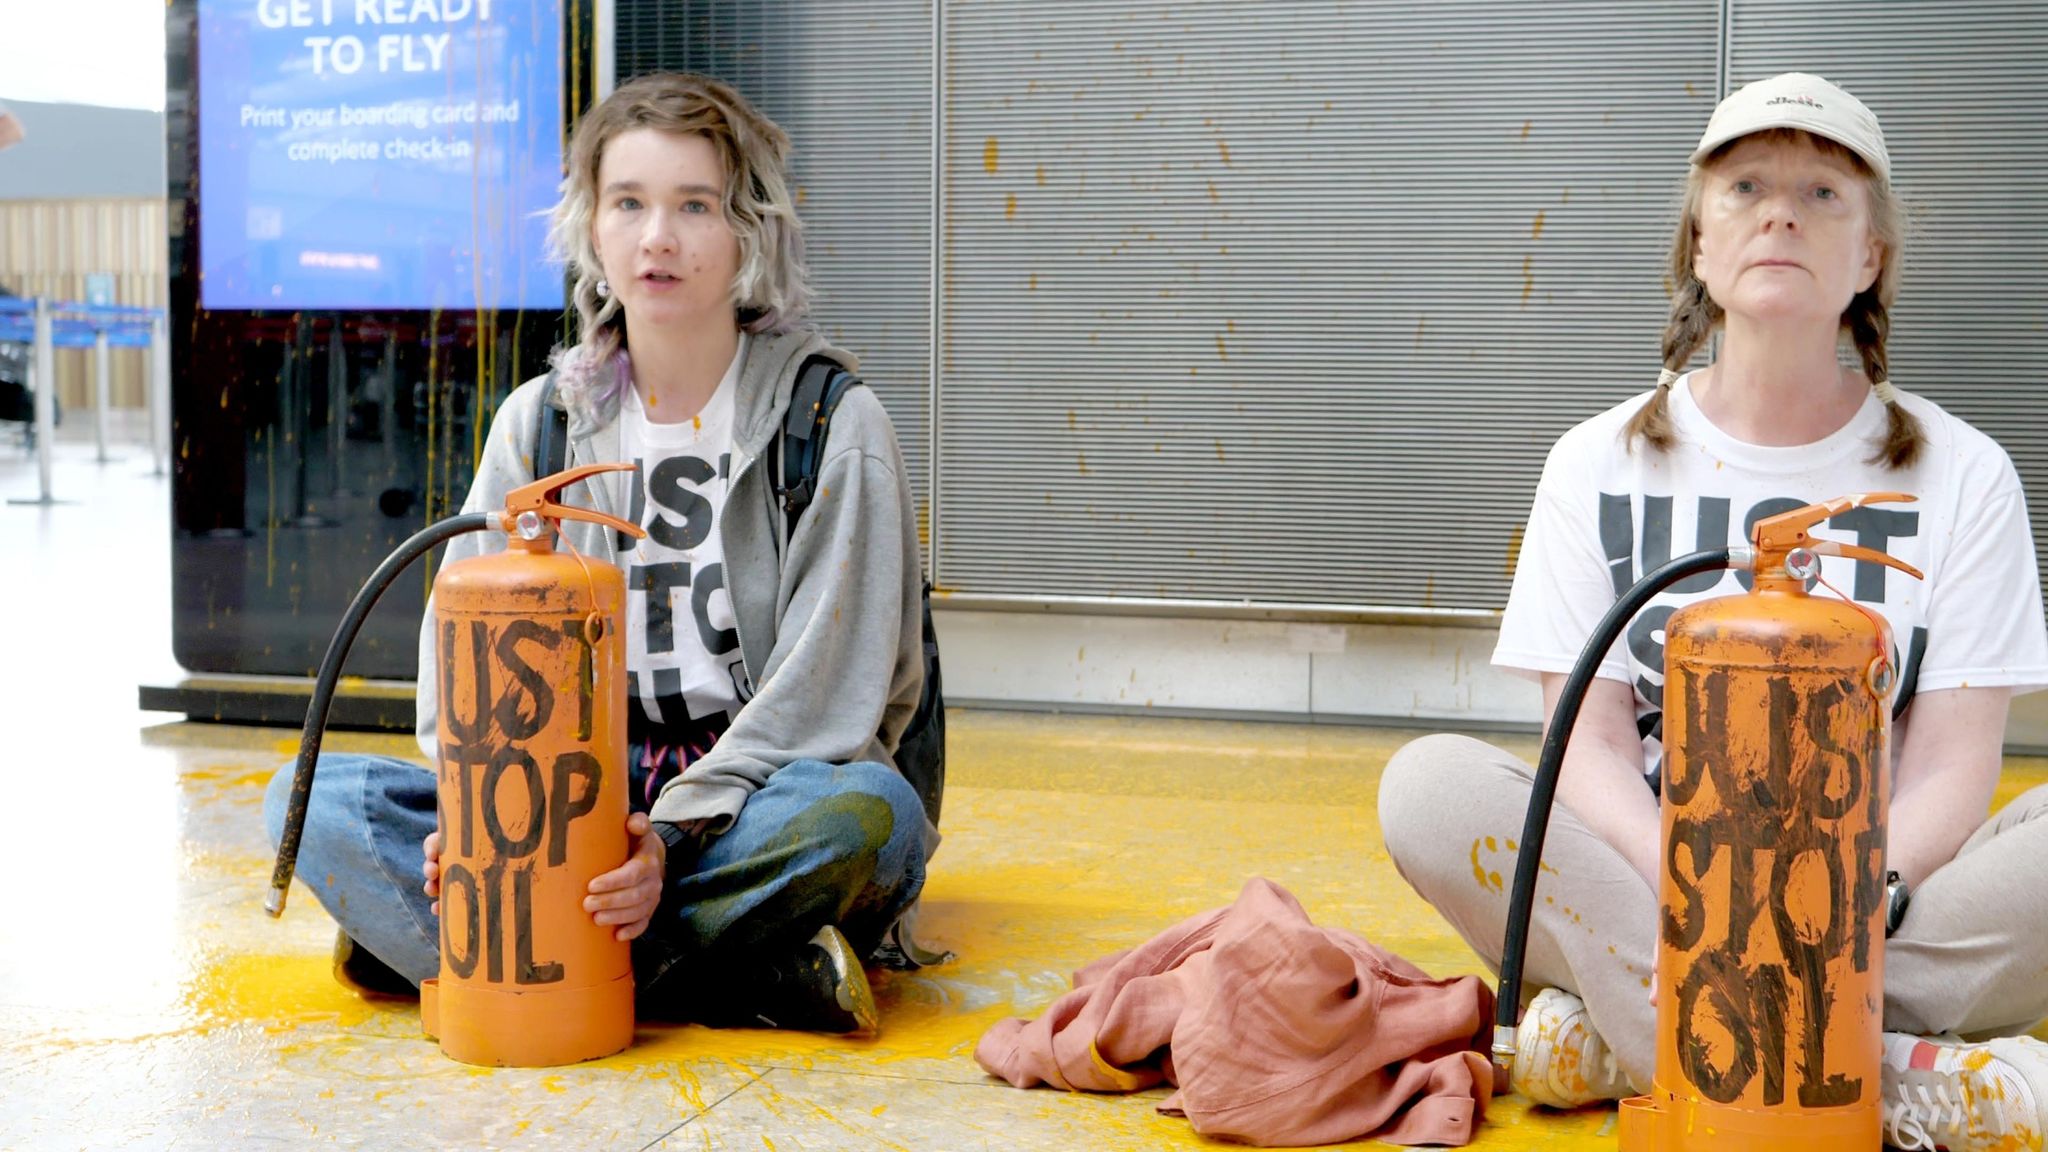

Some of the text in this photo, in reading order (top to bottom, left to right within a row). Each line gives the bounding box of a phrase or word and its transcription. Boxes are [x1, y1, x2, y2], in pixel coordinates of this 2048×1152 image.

[257, 0, 334, 28] GET
[303, 32, 450, 75] TO FLY
[240, 99, 520, 129] Print your boarding card and
[287, 136, 471, 164] complete check-in
[436, 617, 614, 743] UST
[442, 862, 565, 985] OIL
